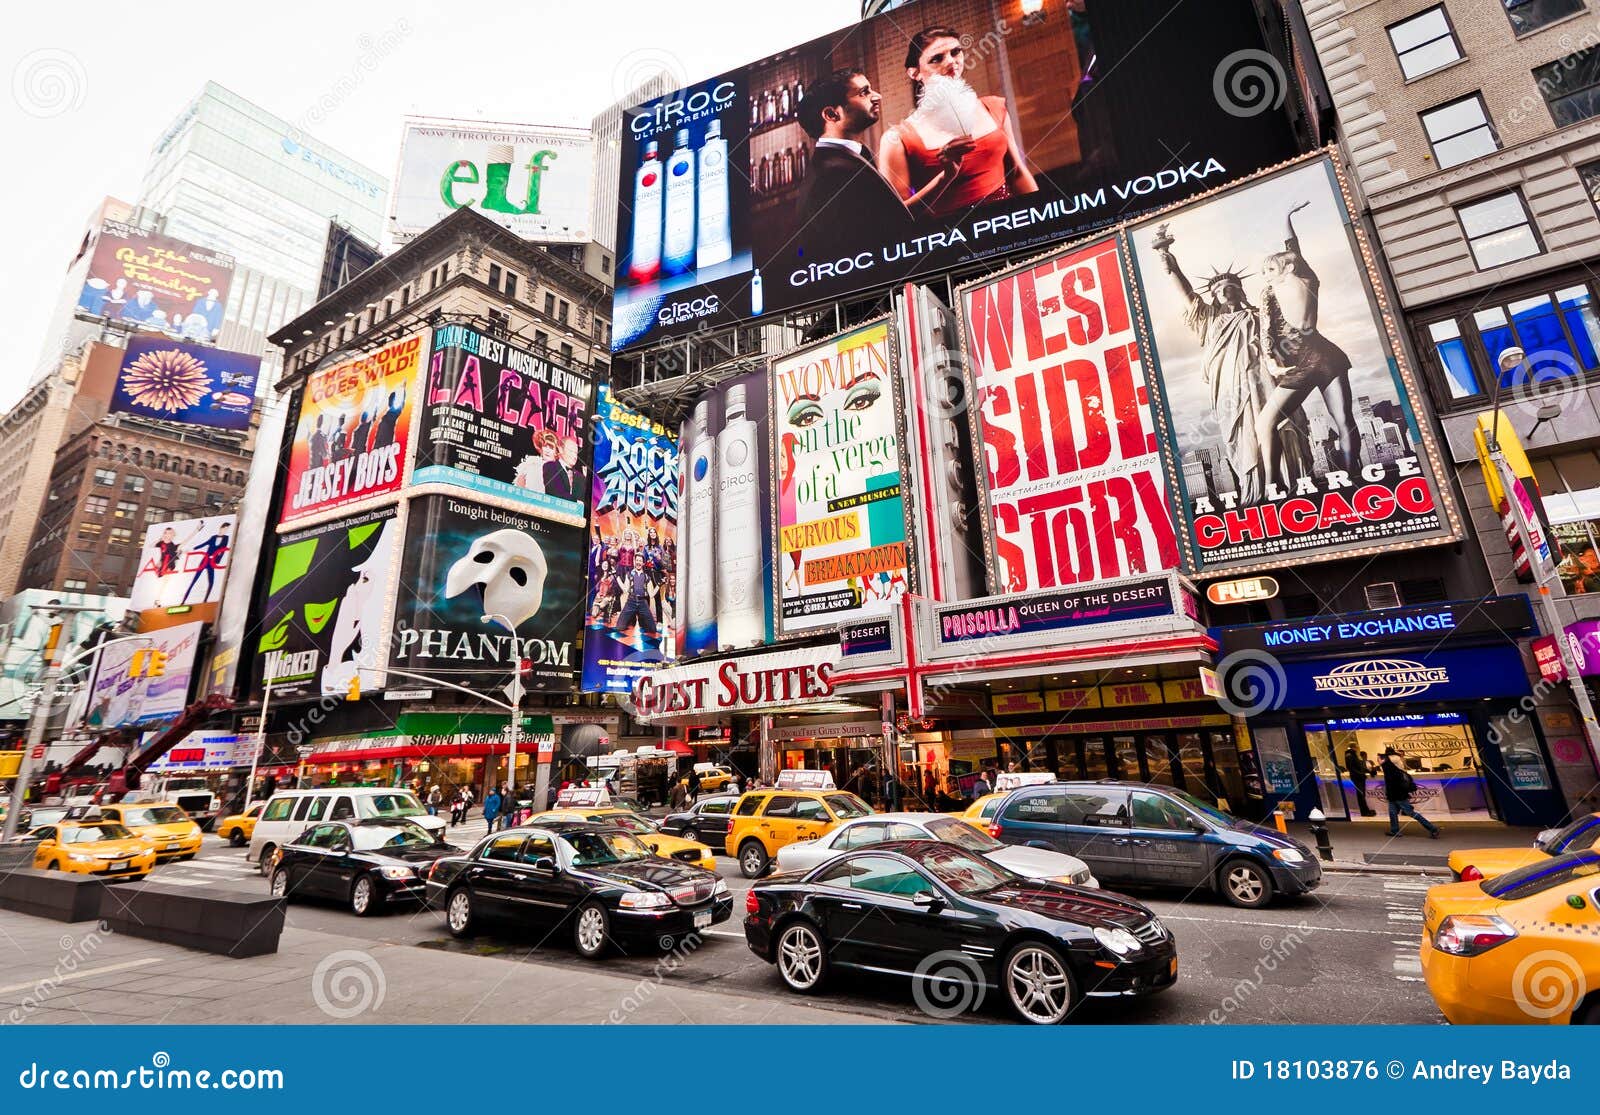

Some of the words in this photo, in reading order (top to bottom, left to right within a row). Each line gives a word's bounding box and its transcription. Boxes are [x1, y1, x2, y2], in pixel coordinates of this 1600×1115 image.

[417, 127, 446, 139] NOW
[451, 132, 513, 144] THROUGH
[513, 135, 565, 148] JANUARY
[634, 123, 671, 141] ULTRA
[676, 101, 733, 126] PREMIUM
[301, 150, 378, 199] BARCLAYS
[440, 150, 558, 215] elf
[882, 227, 966, 262] ULTRA
[973, 188, 1107, 235] PREMIUM
[1111, 156, 1226, 200] VODKA
[147, 246, 189, 263] The
[122, 262, 203, 301] Family
[658, 318, 674, 328] THE
[675, 313, 695, 324] NEW
[967, 238, 1130, 378] WEST
[352, 336, 420, 372] CROWD
[435, 326, 480, 351] WINNER!
[478, 336, 506, 364] BEST
[507, 352, 549, 383] MUSICAL
[551, 367, 587, 398] REVIVAL
[778, 335, 889, 406] WOMEN
[311, 378, 358, 403] GOES
[427, 351, 484, 413] LA
[496, 368, 586, 448] CAGE
[792, 422, 818, 457] on
[823, 408, 863, 449] the
[979, 341, 1159, 490] SIDE
[597, 422, 680, 482] ROCK
[832, 432, 897, 478] verge
[292, 456, 356, 510] JERSEY
[353, 442, 401, 493] BOYS
[797, 463, 821, 505] of
[824, 474, 840, 500] a
[1194, 491, 1239, 514] AT
[1266, 456, 1422, 501] LARGE
[448, 500, 488, 521] Tonight
[491, 509, 529, 530] belongs
[836, 497, 858, 510] NEW
[859, 488, 901, 506] MUSICAL
[1193, 476, 1436, 549] CHICAGO
[783, 515, 857, 552] NERVOUS
[992, 470, 1182, 594] STORY
[1323, 515, 1338, 523] THE
[137, 547, 230, 578] ALDO
[806, 548, 906, 585] BREAKDOWN
[1216, 579, 1269, 601] FUEL
[943, 606, 1020, 637] PRISCILLA
[1019, 600, 1061, 616] QUEEN
[1063, 598, 1080, 609] OF
[1083, 593, 1109, 606] THE
[1113, 586, 1165, 603] DESERT
[1264, 625, 1333, 647] MONEY
[1339, 612, 1456, 639] EXCHANGE
[397, 629, 572, 667] PHANTOM
[851, 626, 886, 639] DESERT
[634, 676, 710, 717] GUEST
[717, 661, 835, 707] SUITES
[1316, 675, 1365, 690] MONEY
[1368, 669, 1450, 685] EXCHANGE
[409, 733, 455, 746] sbarro
[464, 732, 505, 745] sbarro
[819, 726, 840, 736] GUEST
[841, 725, 866, 734] SUITES
[1405, 740, 1440, 751] CHANGE
